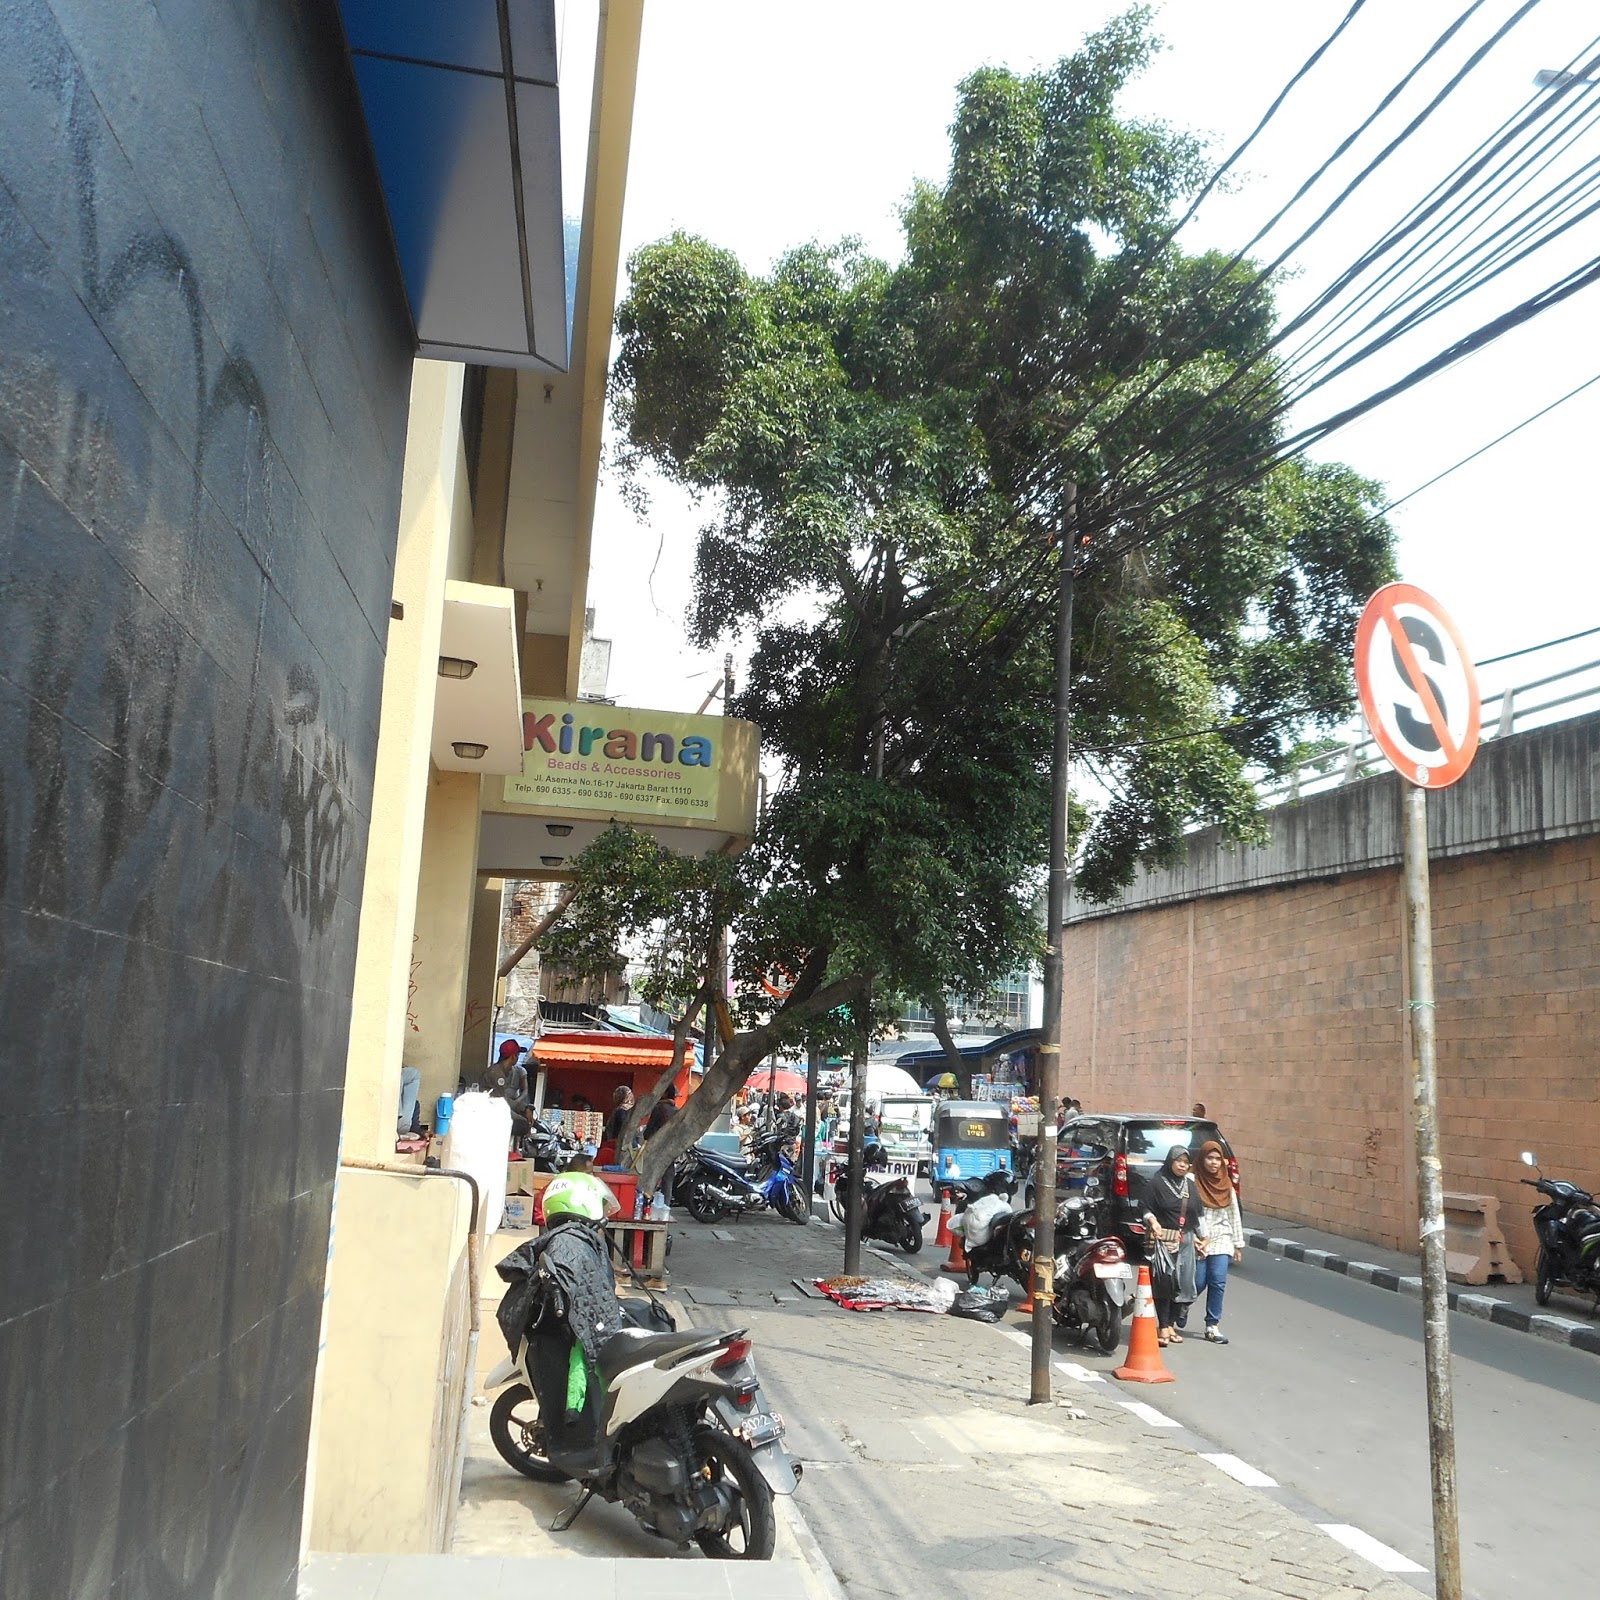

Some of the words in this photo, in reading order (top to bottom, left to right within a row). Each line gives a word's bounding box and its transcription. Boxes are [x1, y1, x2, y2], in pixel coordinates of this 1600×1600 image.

[522, 711, 713, 768] Kirana
[547, 757, 587, 771] Beads
[591, 761, 600, 773] &
[603, 763, 681, 780] Accessories
[514, 783, 534, 793] Telp.
[535, 785, 550, 793] 690
[552, 787, 571, 795] 6335
[577, 788, 592, 797] 690
[594, 790, 613, 799] 6336
[619, 792, 634, 801] 690
[635, 794, 654, 803] 6337
[674, 797, 689, 806] 690
[690, 799, 709, 808] 6338
[534, 774, 543, 782] Jl.
[545, 775, 578, 784] Asemka
[616, 781, 645, 791] Jakarta
[647, 784, 668, 793] Barat
[670, 786, 692, 795] 11110
